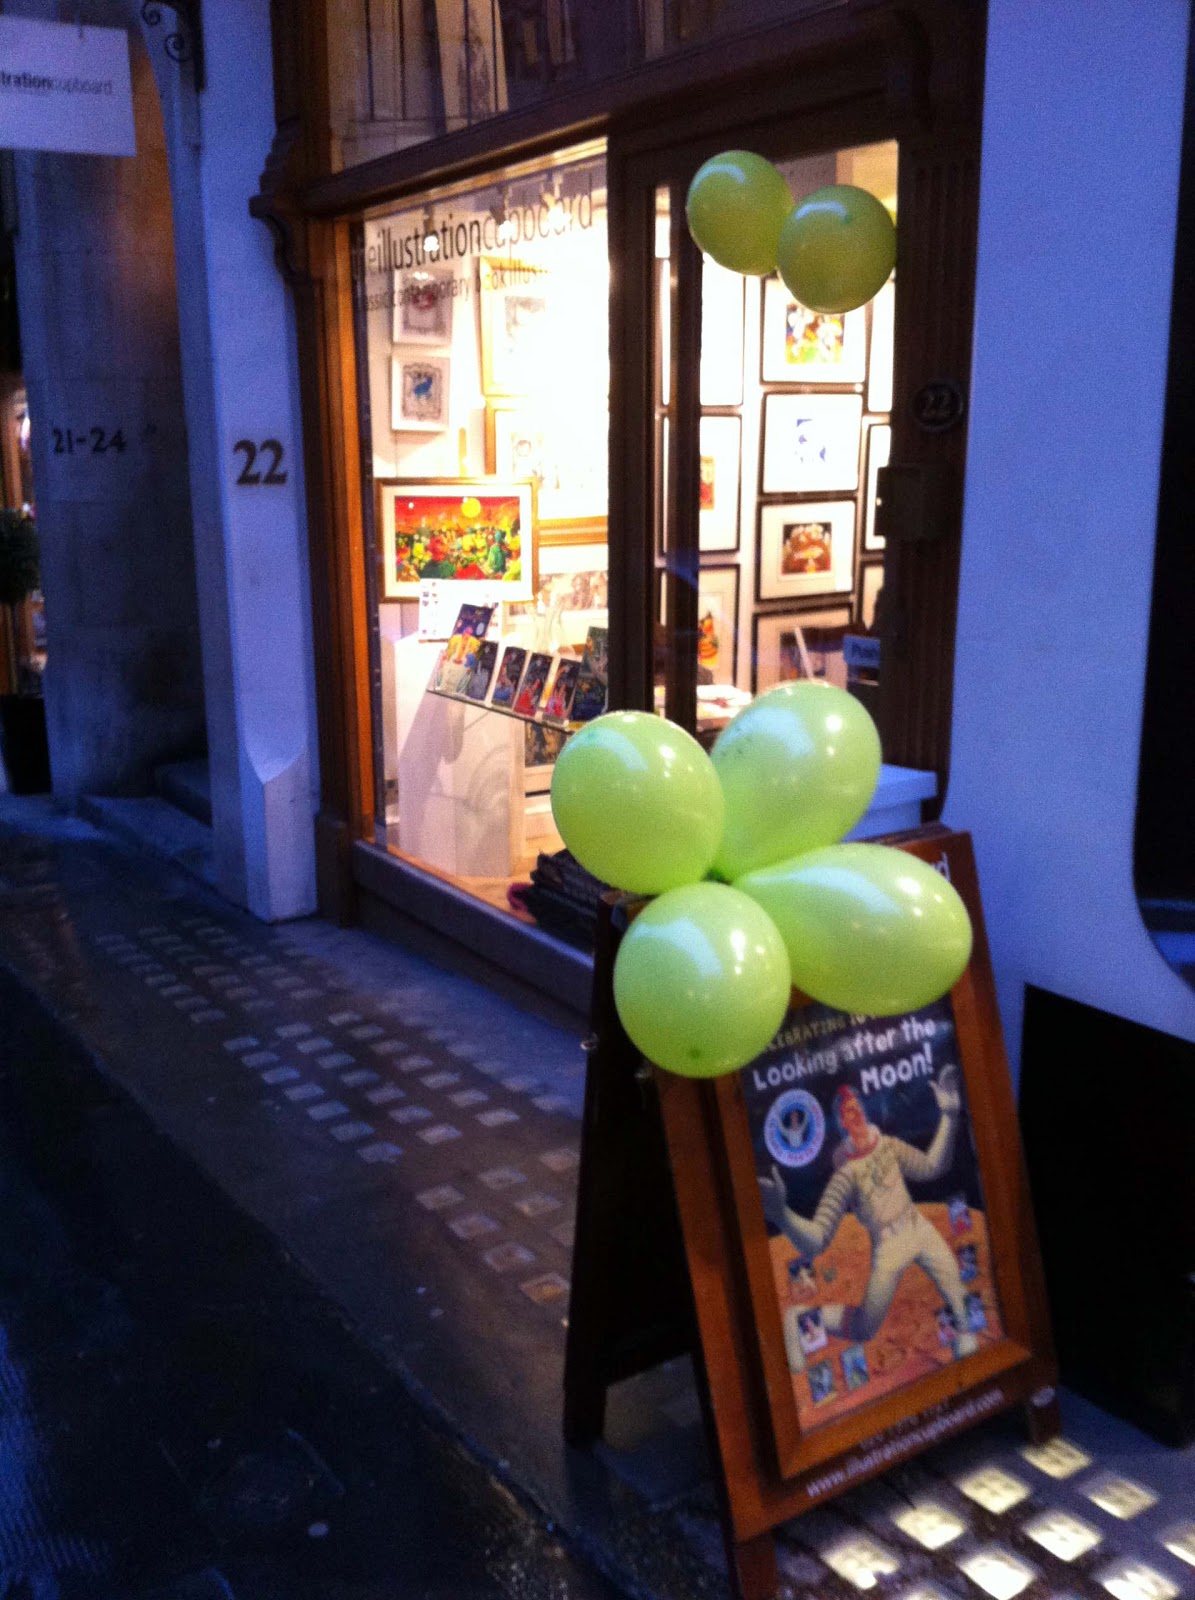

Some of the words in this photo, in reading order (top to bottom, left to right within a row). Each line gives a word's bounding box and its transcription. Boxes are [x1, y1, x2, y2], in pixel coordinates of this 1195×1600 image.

[352, 172, 594, 275] eillustrationcupboard
[53, 427, 127, 453] 21-24
[233, 438, 287, 486] 22
[753, 1050, 838, 1091] Looking
[840, 1027, 896, 1063] after
[902, 1015, 937, 1043] the
[860, 1041, 934, 1096] Moon!
